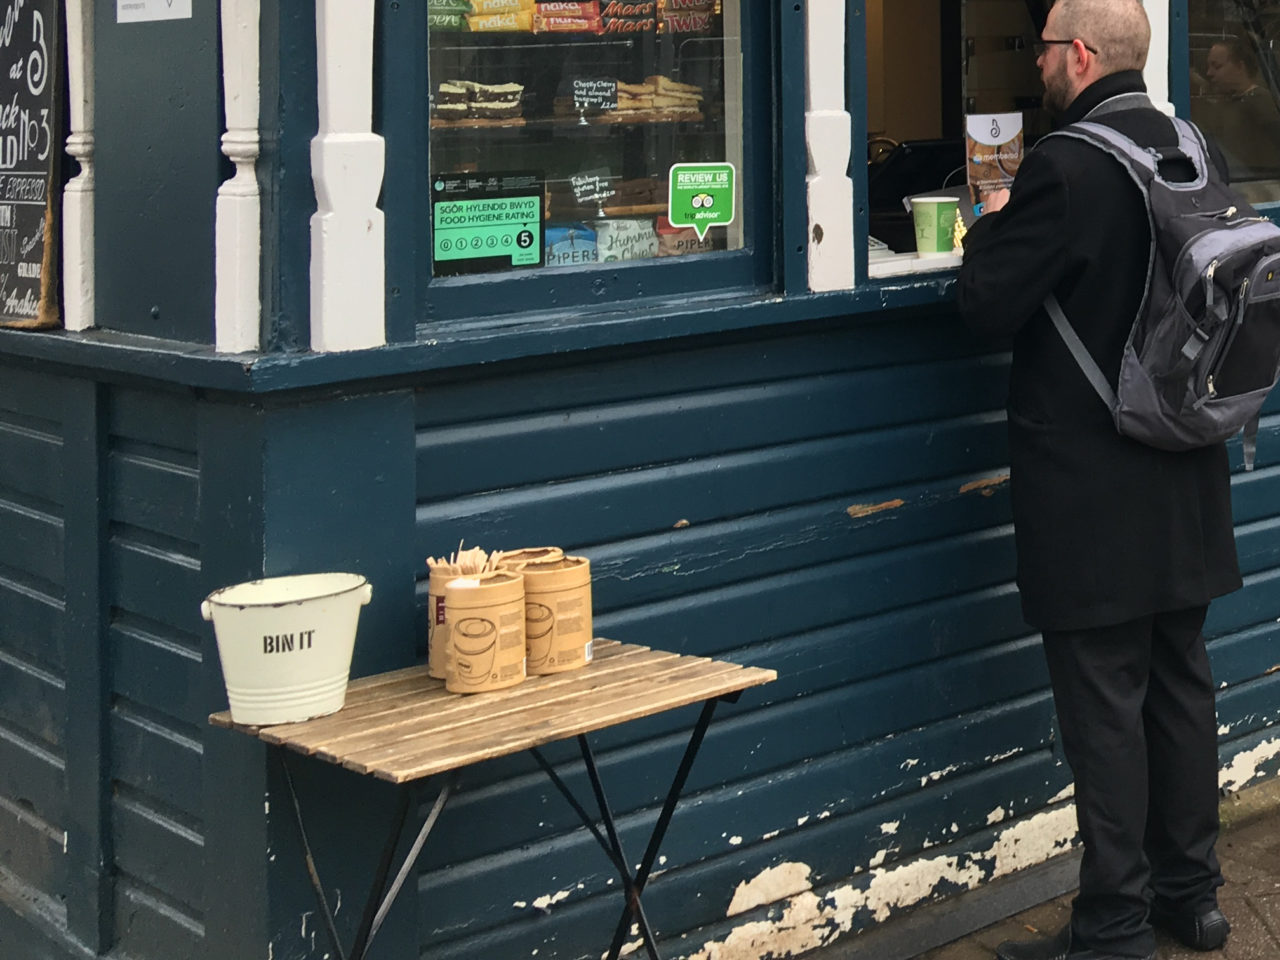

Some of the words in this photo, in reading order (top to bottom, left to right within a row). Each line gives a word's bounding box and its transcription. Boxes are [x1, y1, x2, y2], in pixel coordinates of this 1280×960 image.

[601, 0, 653, 16] Mars
[604, 17, 655, 32] Mars
[663, 12, 711, 33] Twix
[38, 109, 50, 160] 3
[678, 173, 712, 183] REVIEW
[716, 172, 728, 182] US
[440, 203, 463, 214] SGÔR
[466, 202, 507, 212] HYLENDID
[510, 200, 535, 210] BWYD
[440, 216, 466, 225] FOOD
[468, 213, 504, 223] HYGIENE
[505, 211, 535, 220] RATING
[684, 211, 719, 220] tripadvisor
[443, 241, 449, 249] 0
[474, 239, 479, 247] 2
[521, 232, 529, 246] 5
[547, 249, 598, 265] PIPERS
[18, 262, 41, 278] GRADE
[263, 634, 294, 654] BIN
[300, 629, 315, 650] IT
